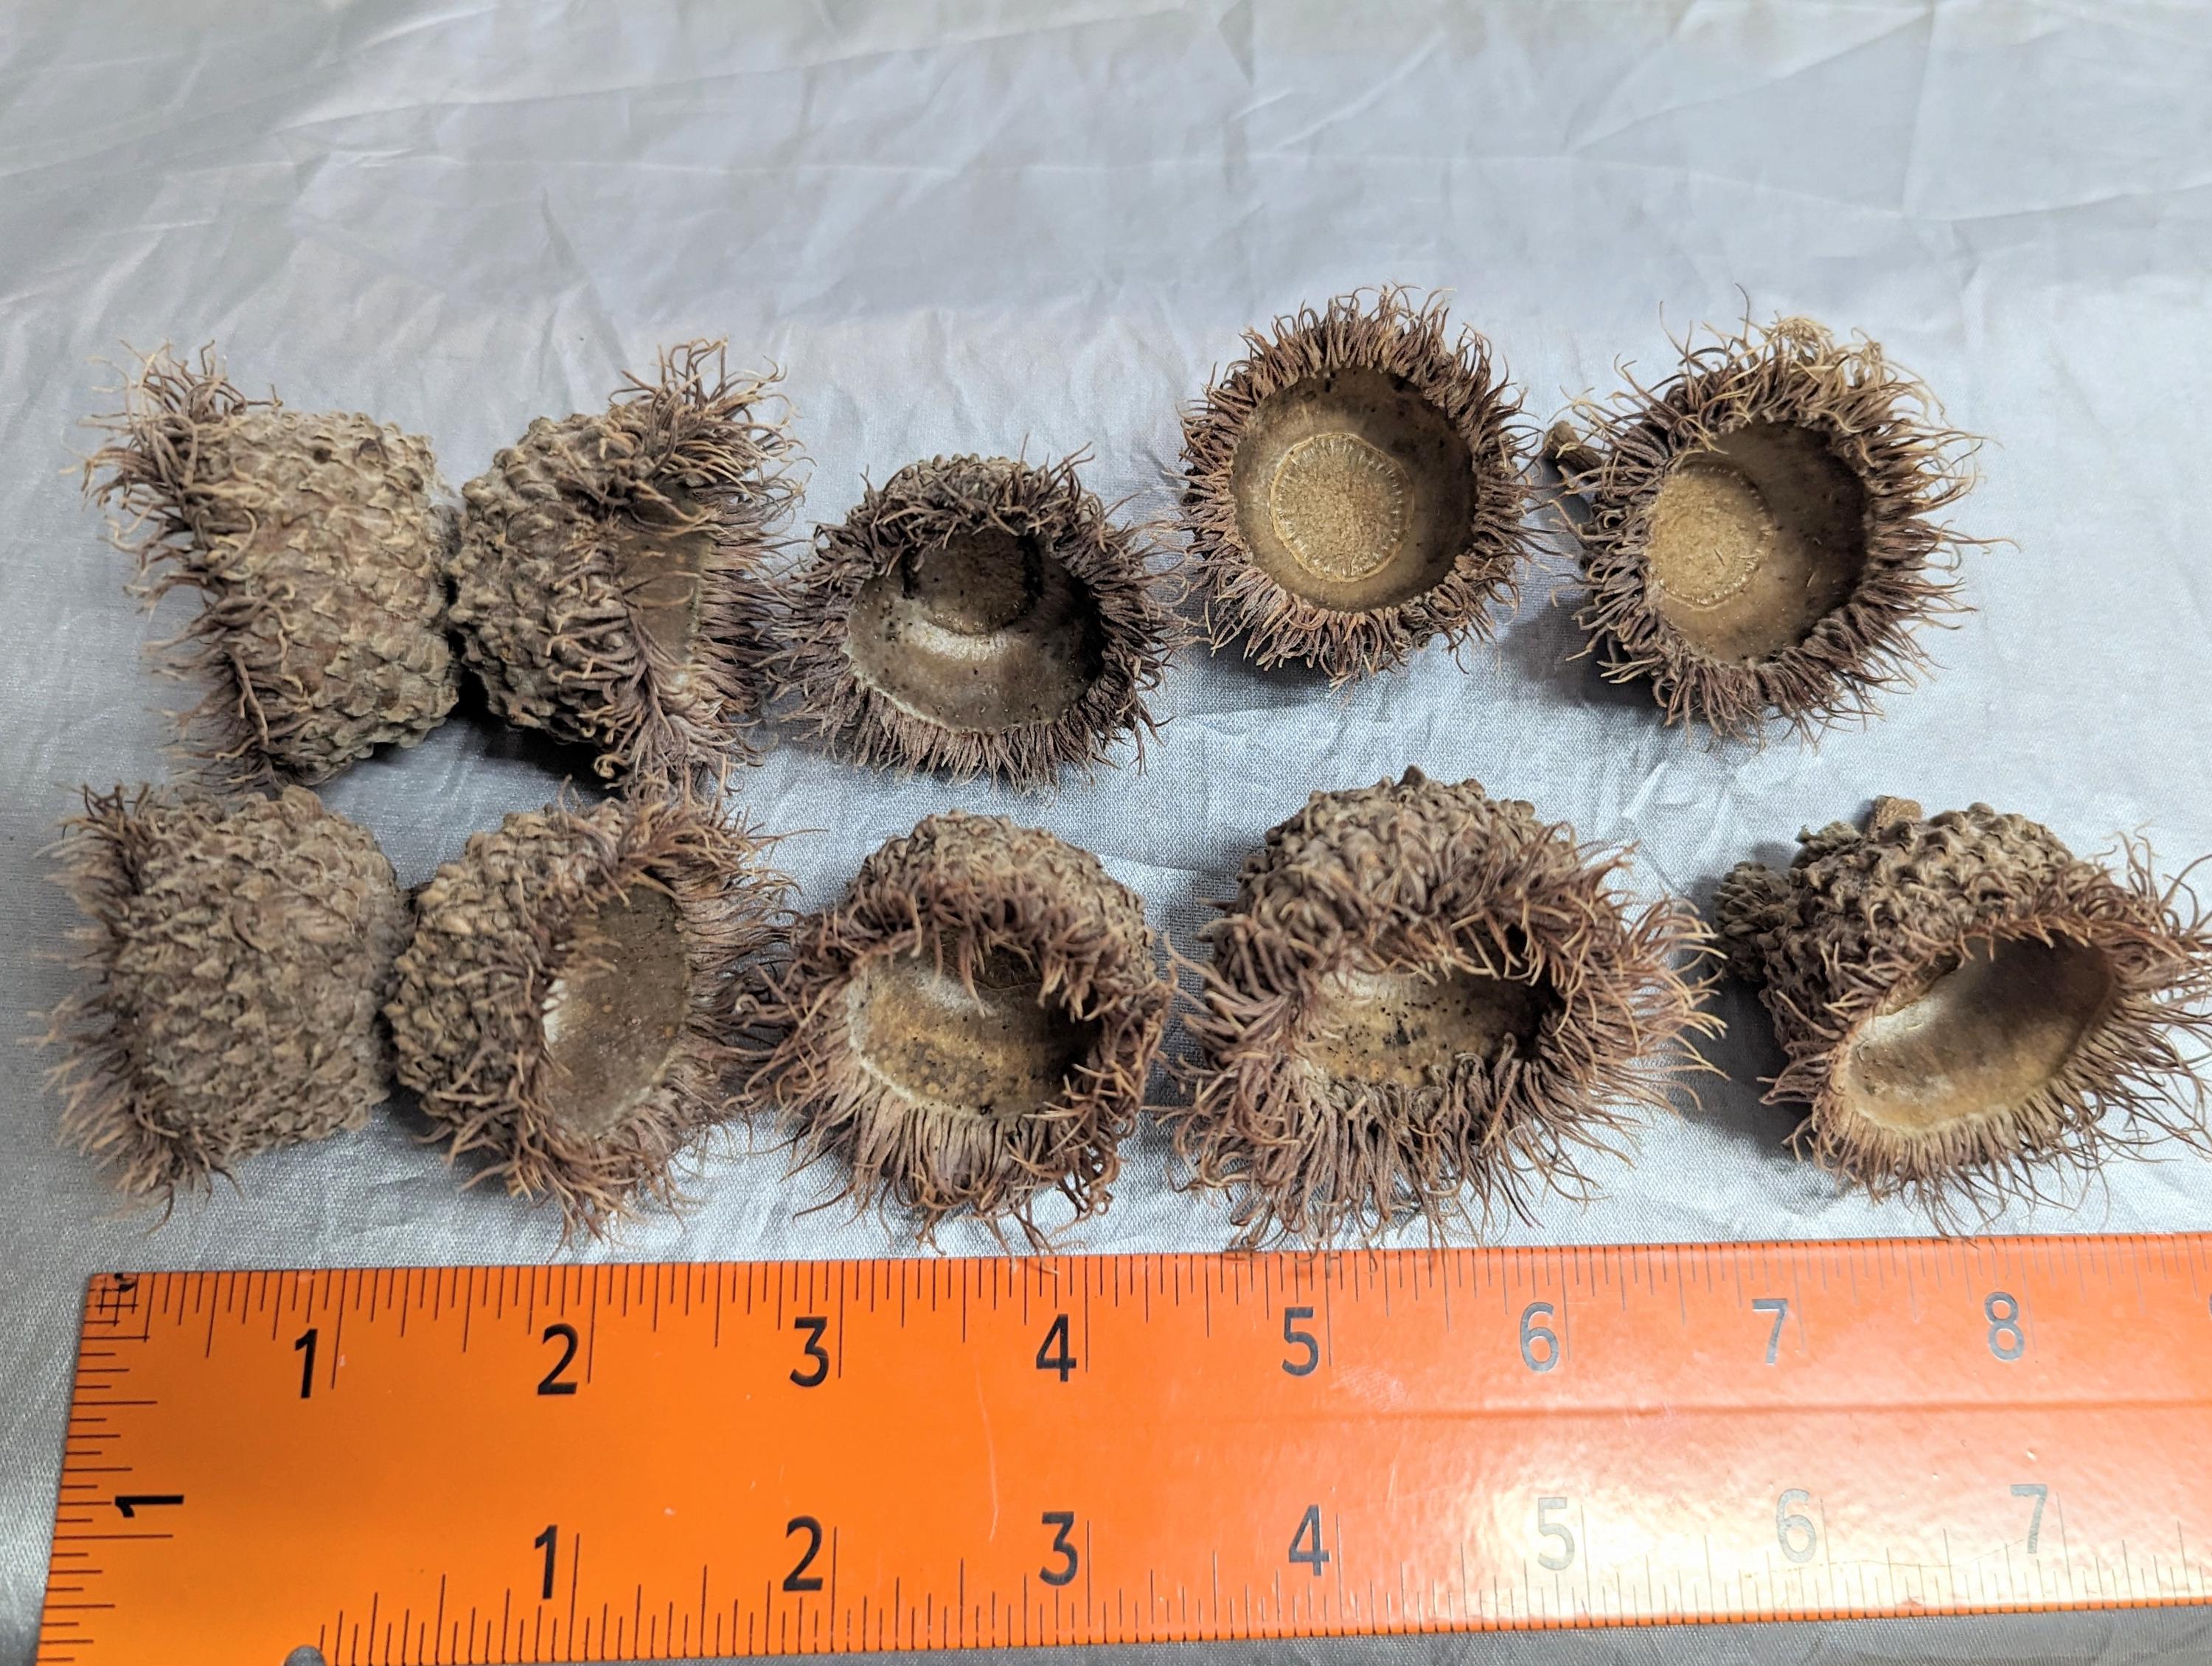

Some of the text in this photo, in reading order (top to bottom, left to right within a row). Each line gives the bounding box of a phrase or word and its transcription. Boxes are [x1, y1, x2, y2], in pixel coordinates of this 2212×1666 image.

[295, 1291, 2025, 1398] 1 2 3 4 5 6 7 8
[114, 1494, 184, 1518] 1
[534, 1483, 2048, 1600] 1 2 3 4 5 6 7
